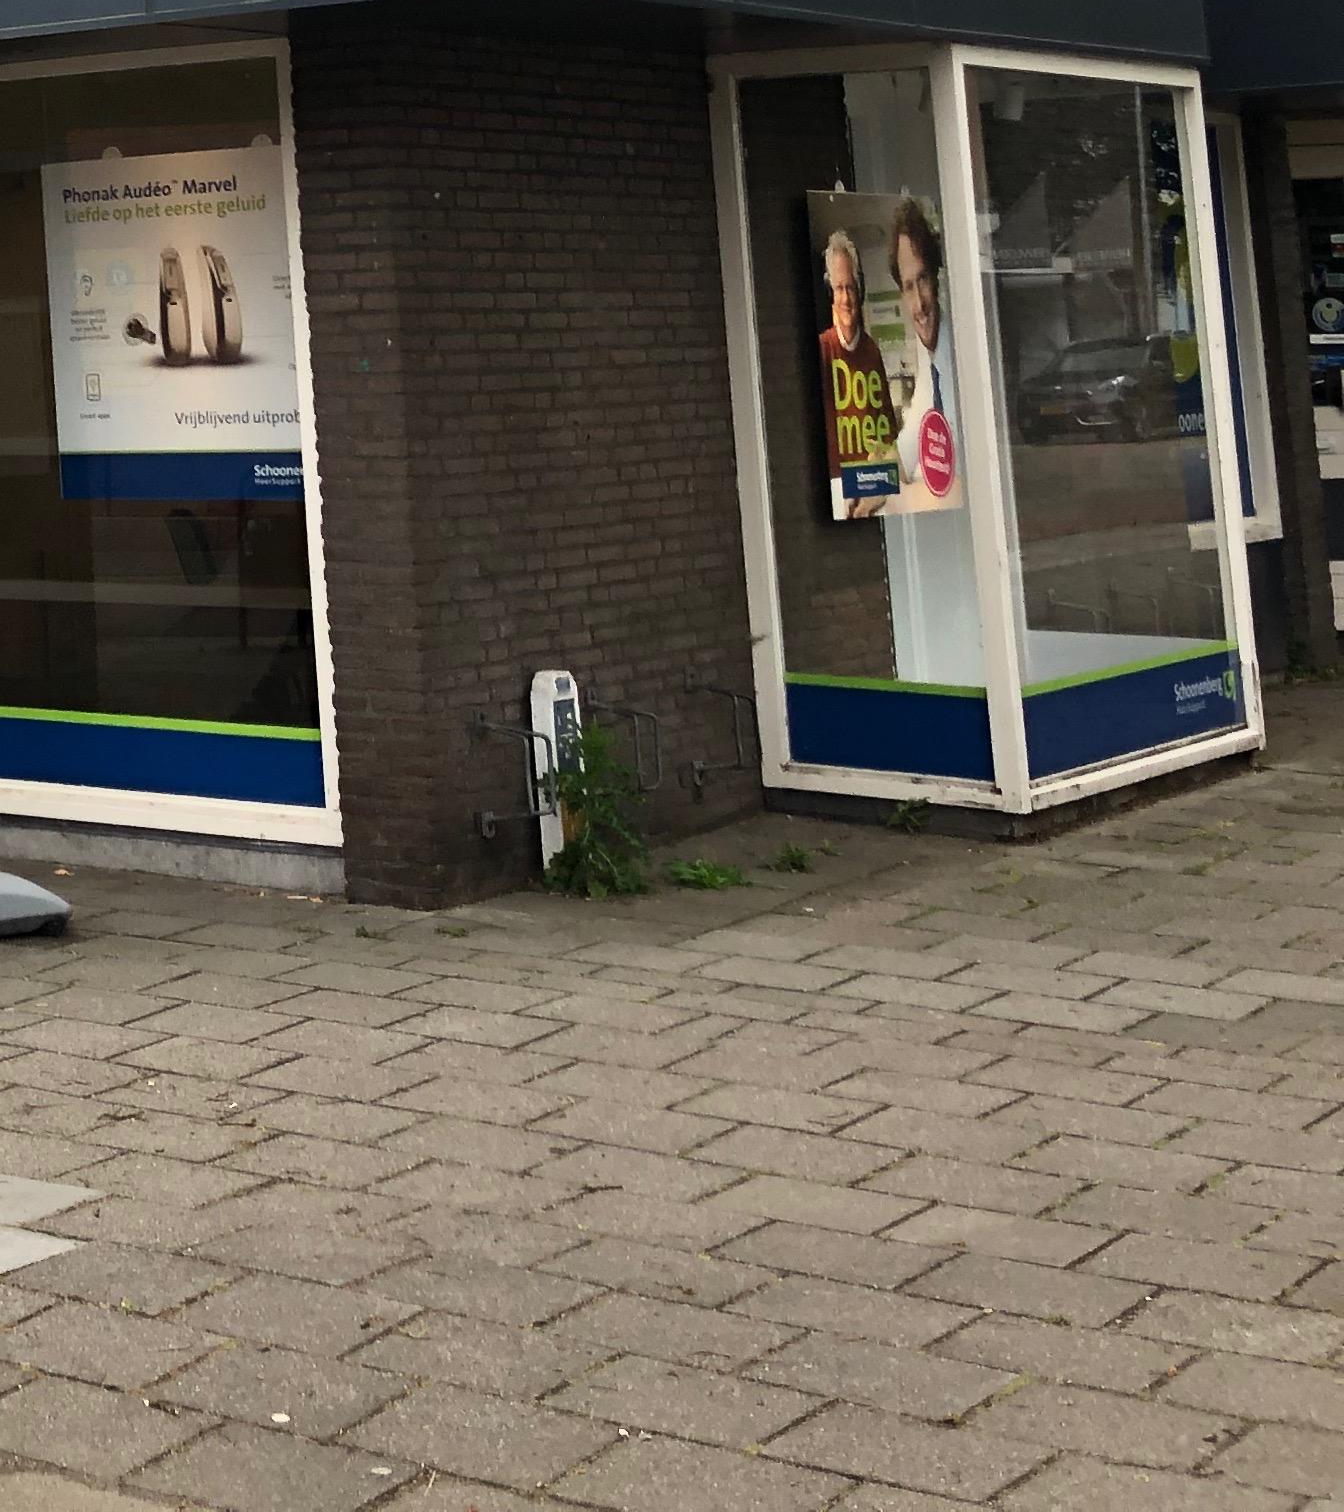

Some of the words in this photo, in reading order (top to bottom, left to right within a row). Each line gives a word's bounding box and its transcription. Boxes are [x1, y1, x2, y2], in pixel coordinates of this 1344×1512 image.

[63, 186, 118, 204] Phonak
[182, 175, 237, 195] Marvel
[64, 204, 109, 224] Liefde
[113, 207, 132, 224] op
[135, 202, 159, 219] het
[164, 199, 212, 216] eerste
[217, 195, 266, 218] geluid
[831, 358, 883, 410] Doe
[175, 411, 249, 428] Vrijblijvend
[836, 414, 890, 455] mee
